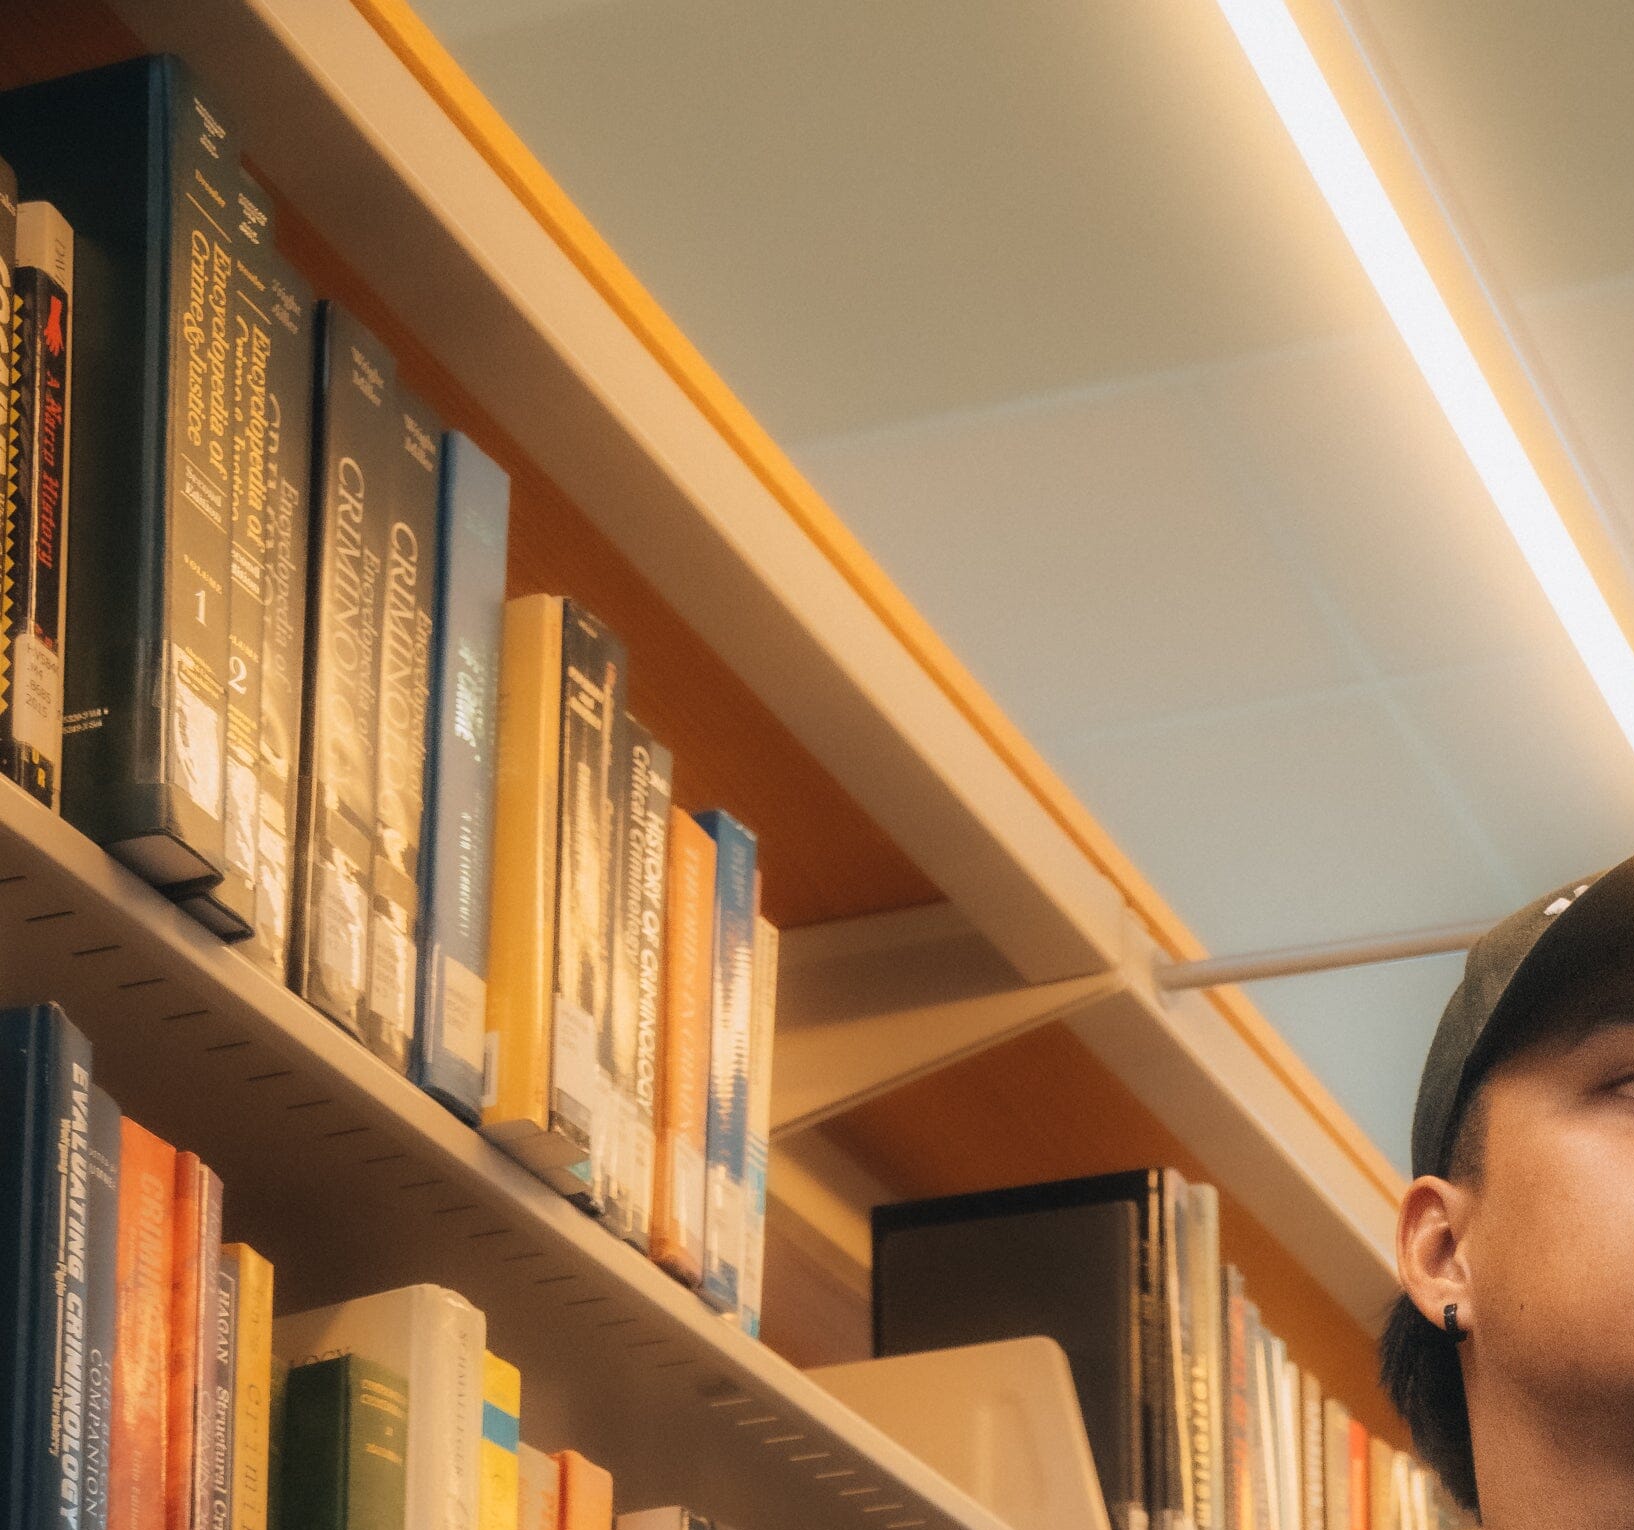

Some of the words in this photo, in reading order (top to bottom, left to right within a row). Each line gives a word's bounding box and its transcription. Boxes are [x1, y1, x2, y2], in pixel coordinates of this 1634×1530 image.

[207, 241, 232, 437] Encyclopedia
[208, 441, 228, 480] of
[246, 324, 271, 512] Encyclopedia
[38, 470, 60, 569] History
[245, 516, 267, 554] of
[273, 476, 299, 647] Encyclopedia
[194, 590, 207, 627] 1
[359, 549, 381, 712] Encyclopedia
[228, 656, 248, 696] 2
[410, 612, 433, 768] Encyclopedia
[631, 746, 651, 824] Critical
[623, 829, 644, 966] Criminology
[642, 812, 662, 906] HISTORY
[641, 911, 659, 944] OF
[636, 949, 660, 1116] CRIMINOLOGY
[68, 1062, 89, 1284] EVALUATING
[215, 1288, 231, 1365] HAGAN
[86, 1349, 103, 1524] COMPANION
[213, 1386, 230, 1495] Structural
